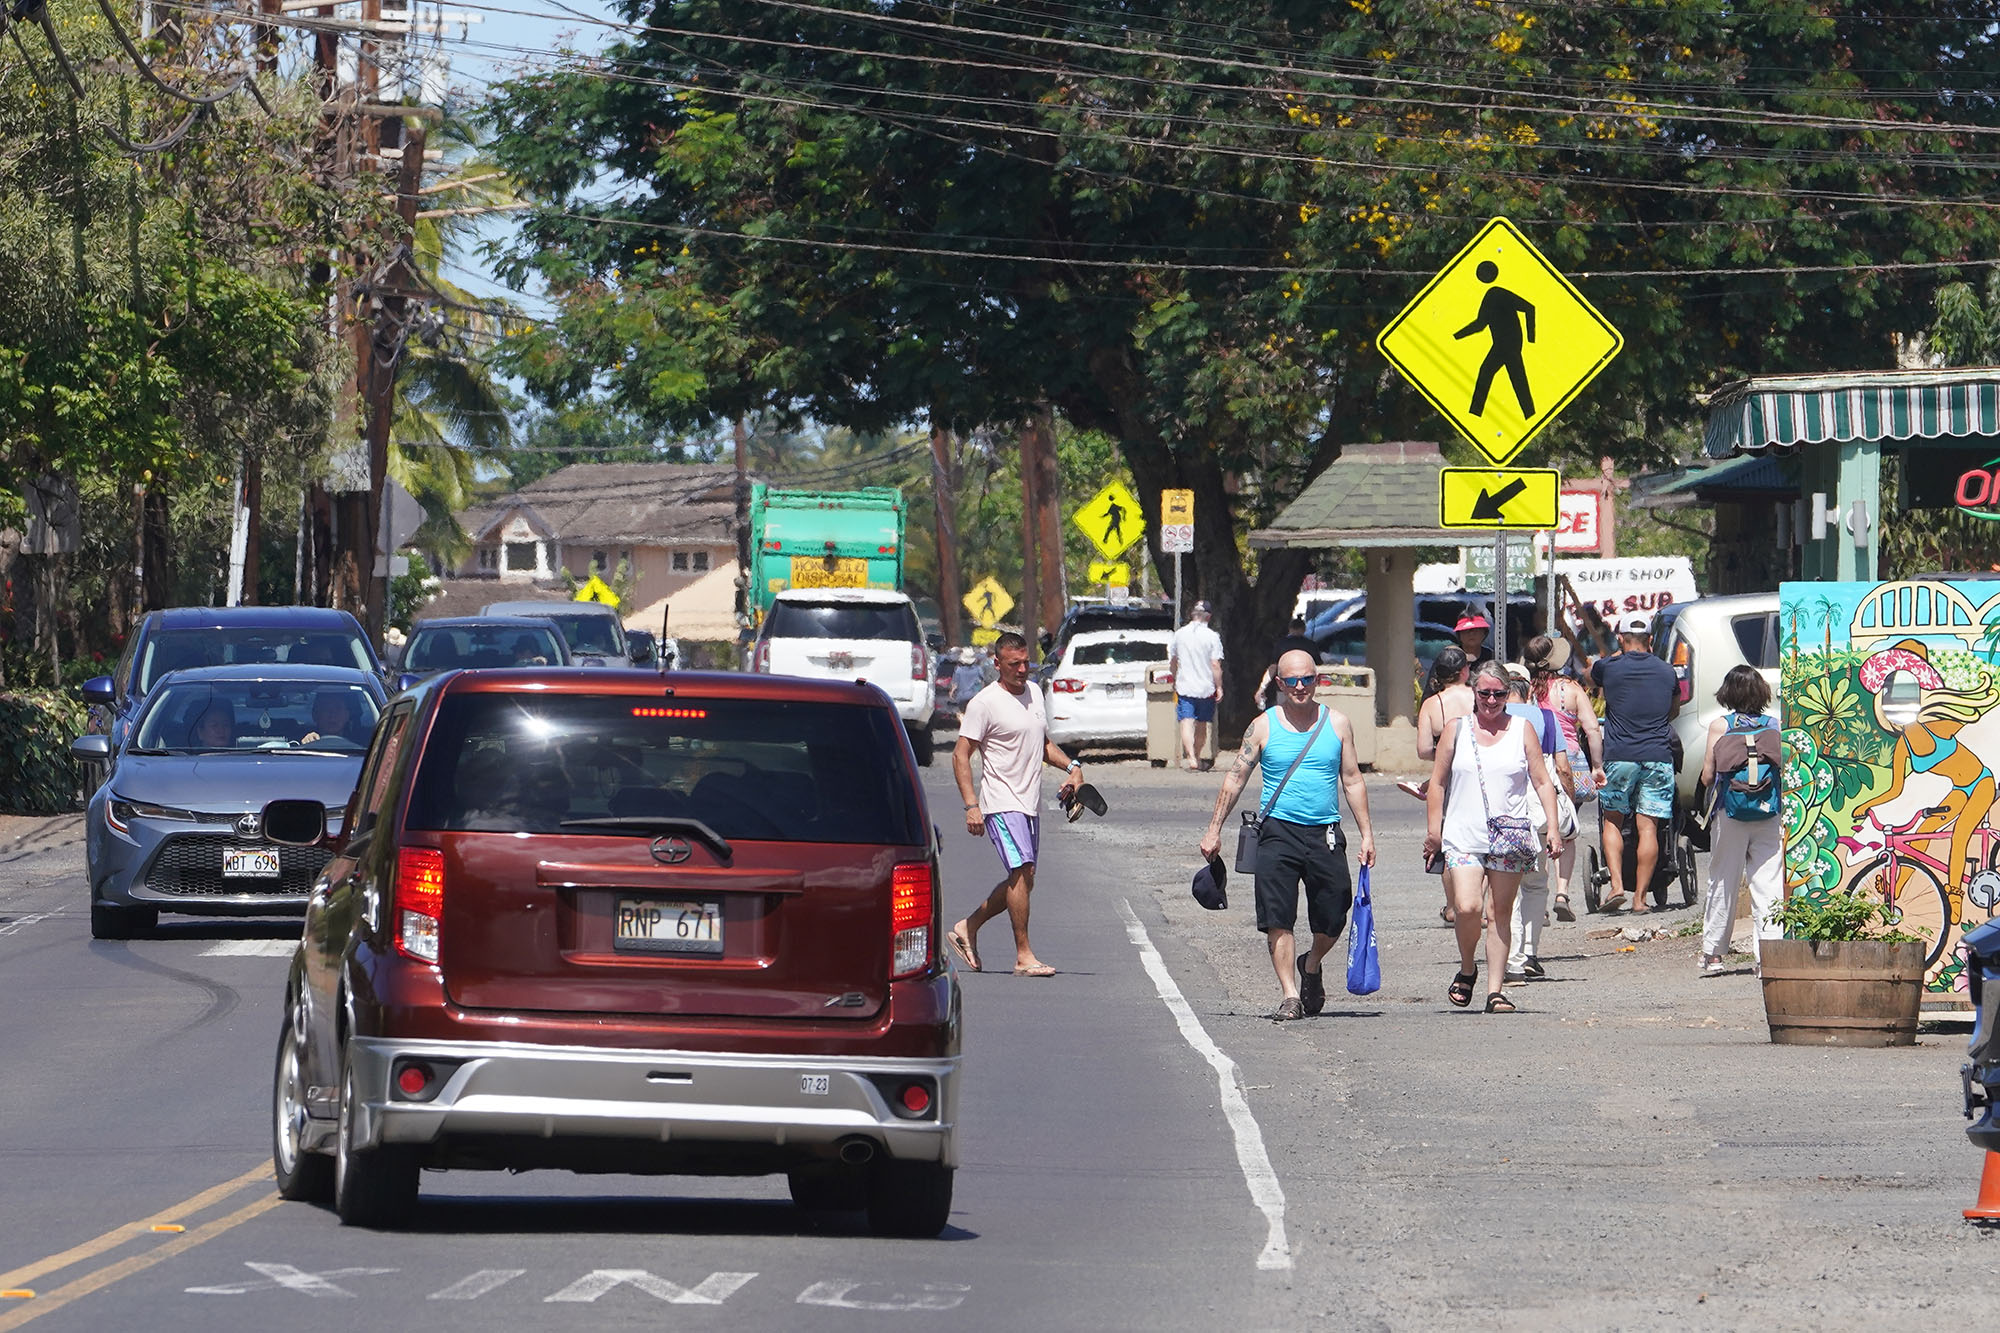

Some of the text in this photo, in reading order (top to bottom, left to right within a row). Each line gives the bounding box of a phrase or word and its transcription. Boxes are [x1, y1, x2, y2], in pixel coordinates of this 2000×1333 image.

[1629, 568, 1675, 580] SHOP
[225, 855, 278, 870] WBT 698
[619, 908, 713, 939] RNP 671
[184, 1261, 972, 1311] XING
